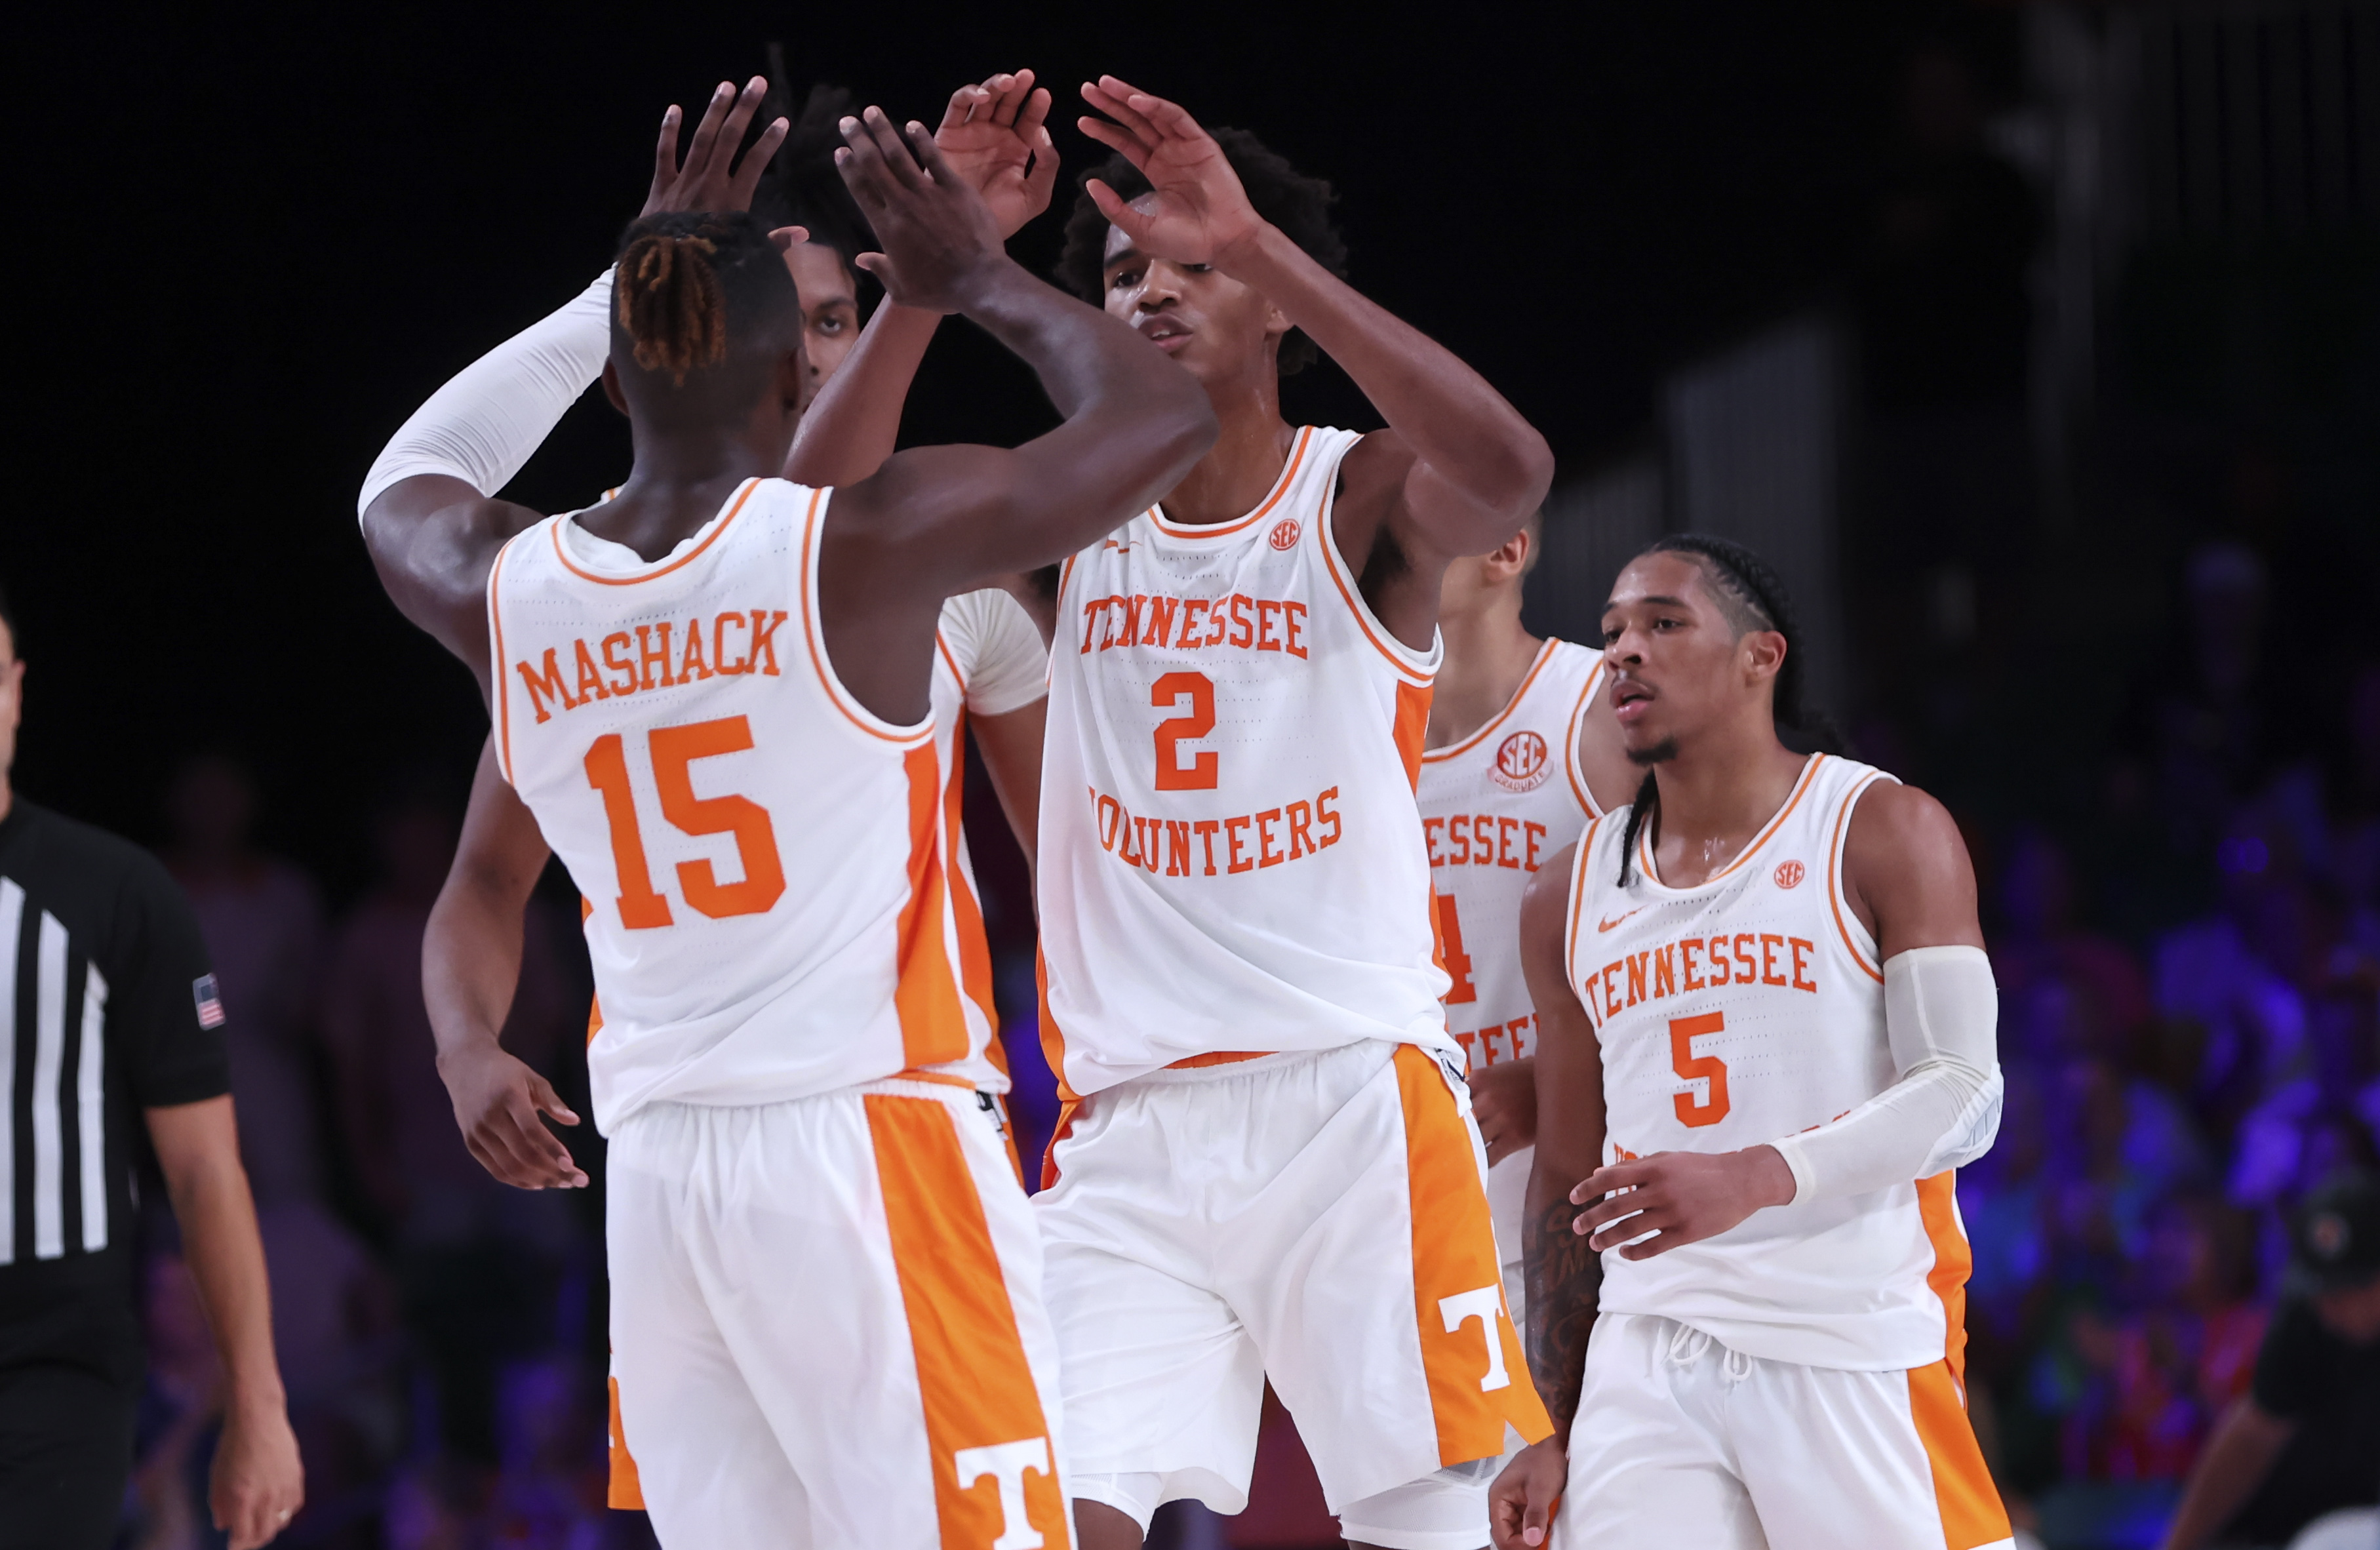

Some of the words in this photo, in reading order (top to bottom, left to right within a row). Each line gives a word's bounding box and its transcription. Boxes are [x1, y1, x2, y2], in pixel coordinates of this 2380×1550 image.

[1272, 521, 1297, 547] SEC
[516, 609, 788, 724] MASHACK
[1081, 593, 1308, 660] TENNESSEE
[1151, 671, 1219, 791] 2
[1501, 733, 1543, 776] SEC
[584, 714, 786, 930] 15
[1089, 785, 1341, 877] OLUNTEERS
[1777, 863, 1802, 886] SEC
[1585, 932, 1817, 1029] TENNESSEE
[1669, 1010, 1731, 1128] 5
[1438, 1282, 1511, 1392] T
[954, 1436, 1050, 1550] T
